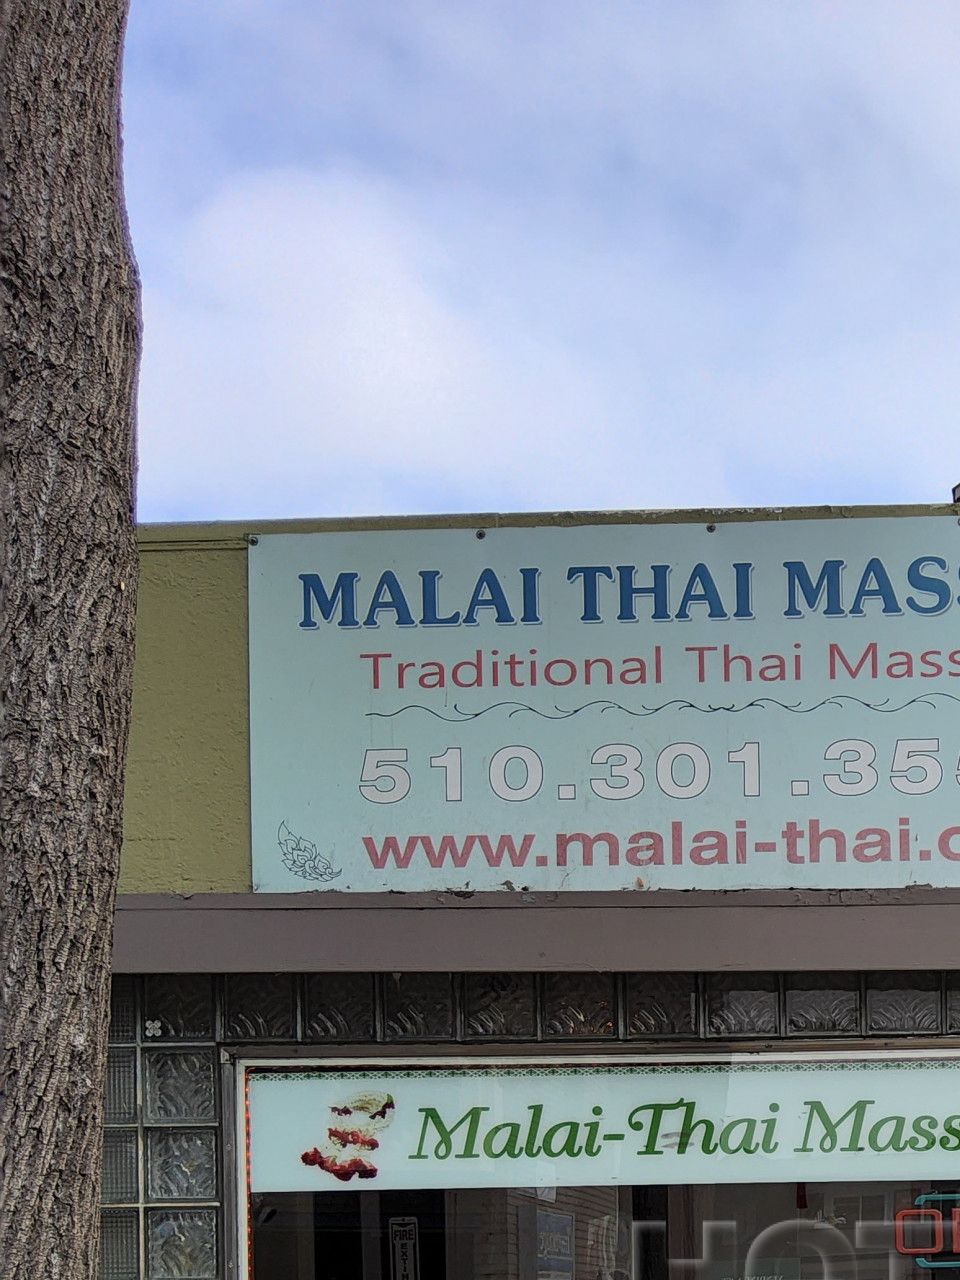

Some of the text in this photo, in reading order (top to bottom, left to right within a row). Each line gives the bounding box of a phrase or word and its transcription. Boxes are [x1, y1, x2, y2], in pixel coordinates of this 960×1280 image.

[299, 567, 543, 630] MALAI
[566, 562, 754, 624] THAI
[360, 646, 662, 690] Traditional
[685, 643, 801, 682] Thai
[408, 1098, 780, 1160] Malai-Thai
[393, 1229, 415, 1241] FIRE
